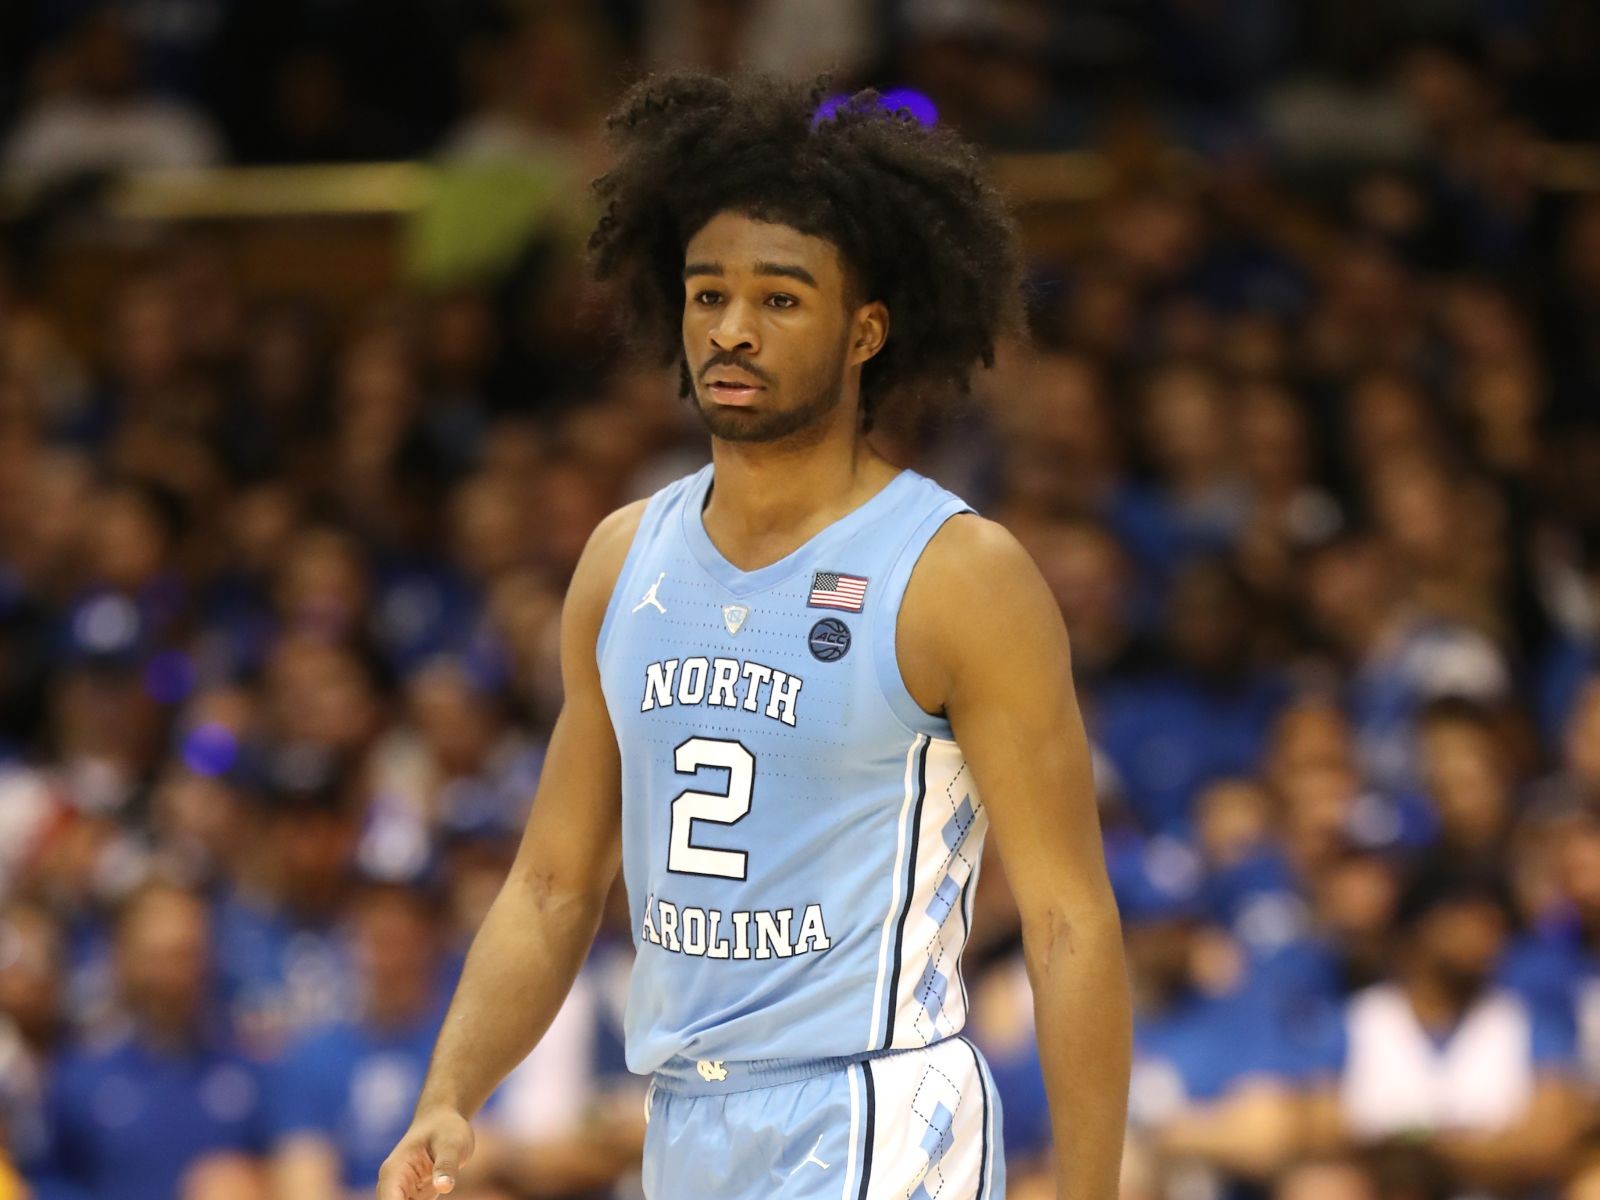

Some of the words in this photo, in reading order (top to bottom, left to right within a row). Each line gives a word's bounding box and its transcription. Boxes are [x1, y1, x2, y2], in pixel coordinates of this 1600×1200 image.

[640, 656, 803, 728] NORTH
[667, 735, 757, 882] 2
[641, 893, 832, 961] AROLINA
